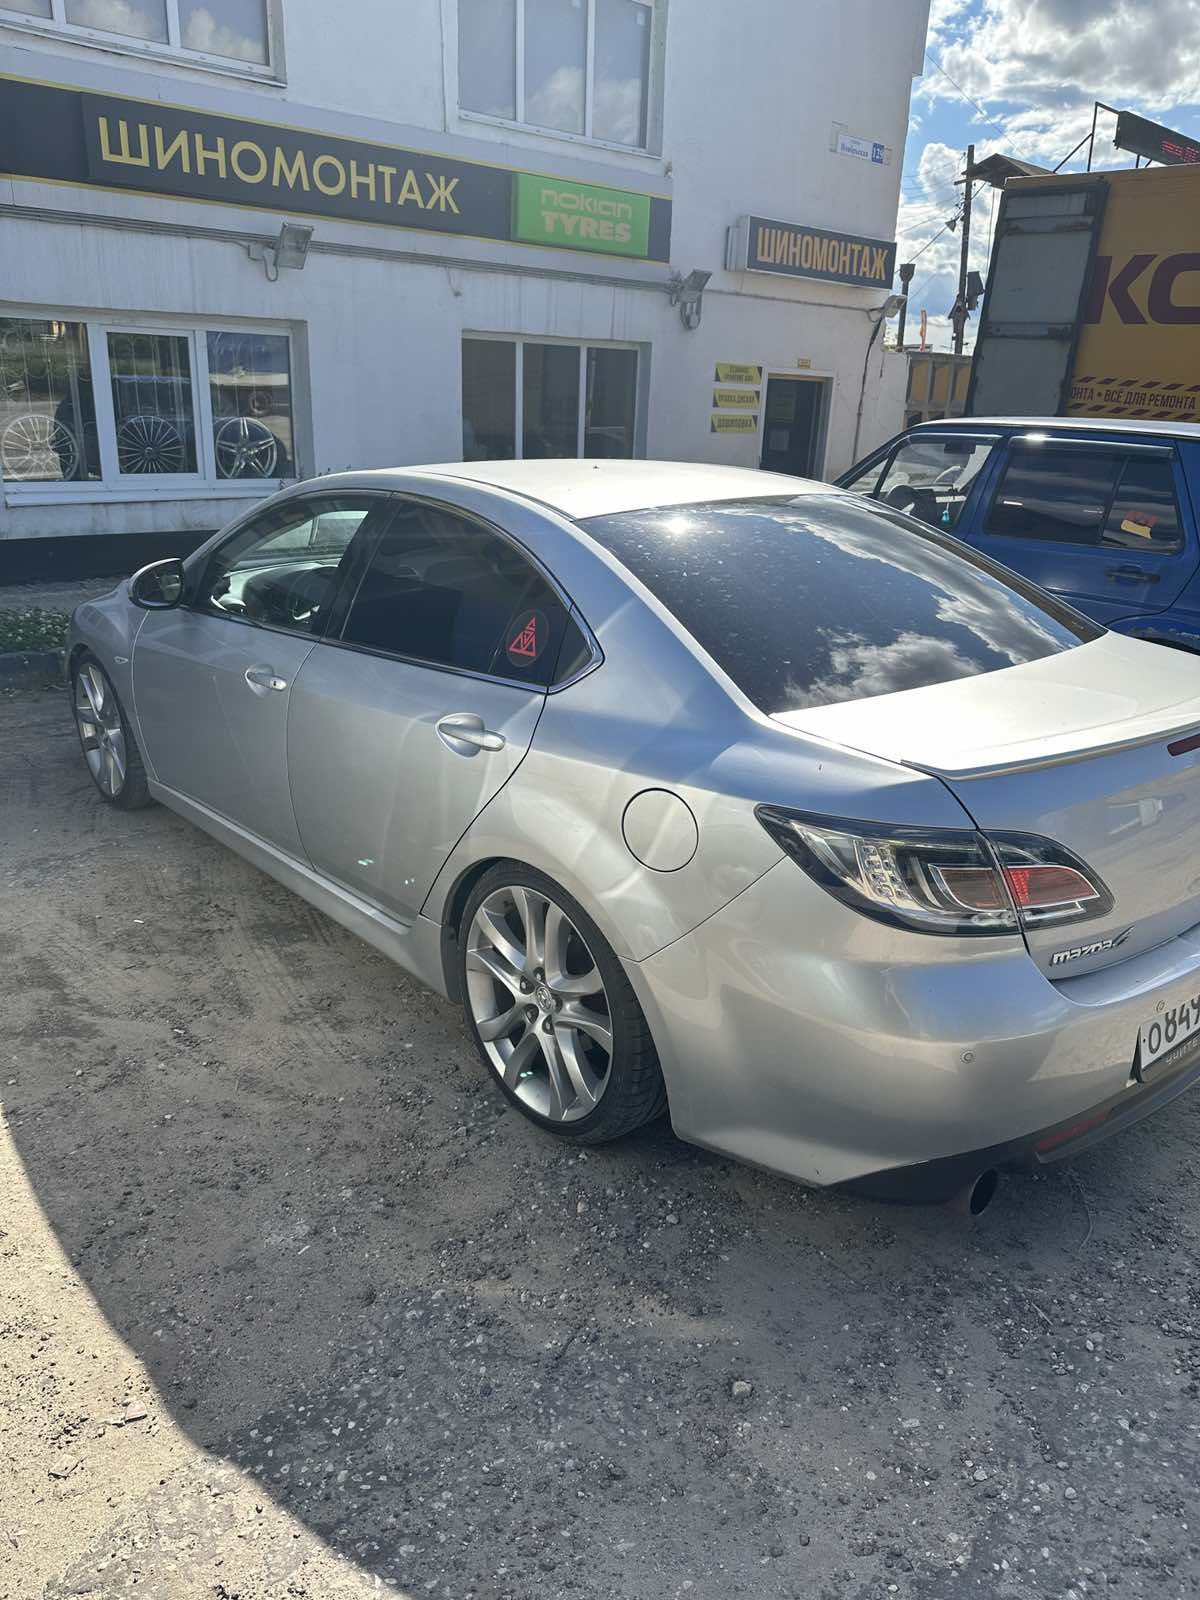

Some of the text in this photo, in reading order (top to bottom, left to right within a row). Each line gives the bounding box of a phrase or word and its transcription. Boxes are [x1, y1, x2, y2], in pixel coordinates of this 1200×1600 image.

[98, 116, 461, 214] ШИНОМОНТАЖ
[541, 210, 631, 242] TYRES
[756, 226, 888, 280] ШИНОМОНТАЖ
[1123, 391, 1146, 407] ДЛЯ
[1147, 393, 1197, 410] РЕМОНТА
